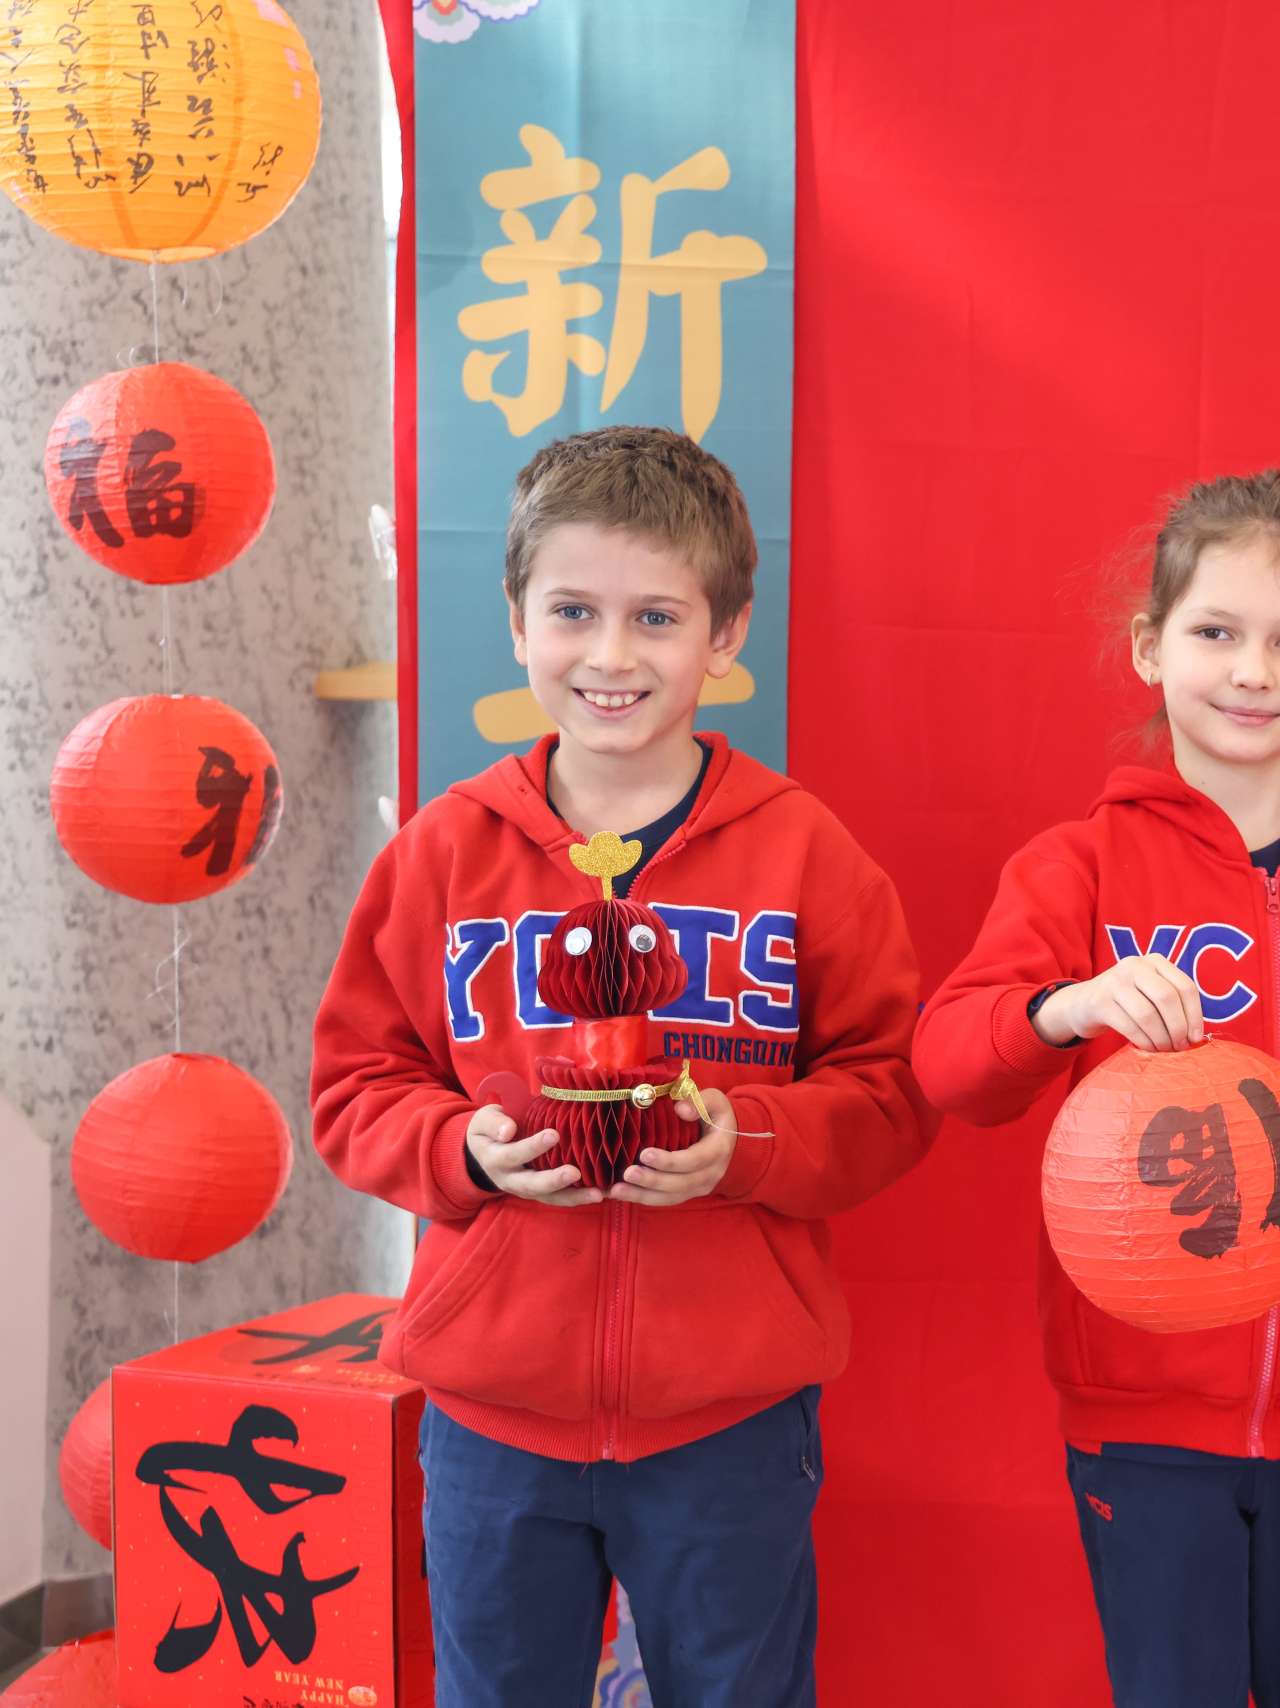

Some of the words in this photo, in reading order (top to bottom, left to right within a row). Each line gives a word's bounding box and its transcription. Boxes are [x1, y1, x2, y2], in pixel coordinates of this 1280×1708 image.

[457, 124, 768, 444] 新
[59, 417, 201, 549] 福
[646, 902, 800, 1033] IS
[663, 1031, 799, 1067] CHONGQIN
[274, 1670, 310, 1685] YEAR
[315, 1677, 344, 1691] NEW
[300, 1689, 344, 1706] HAPPY
